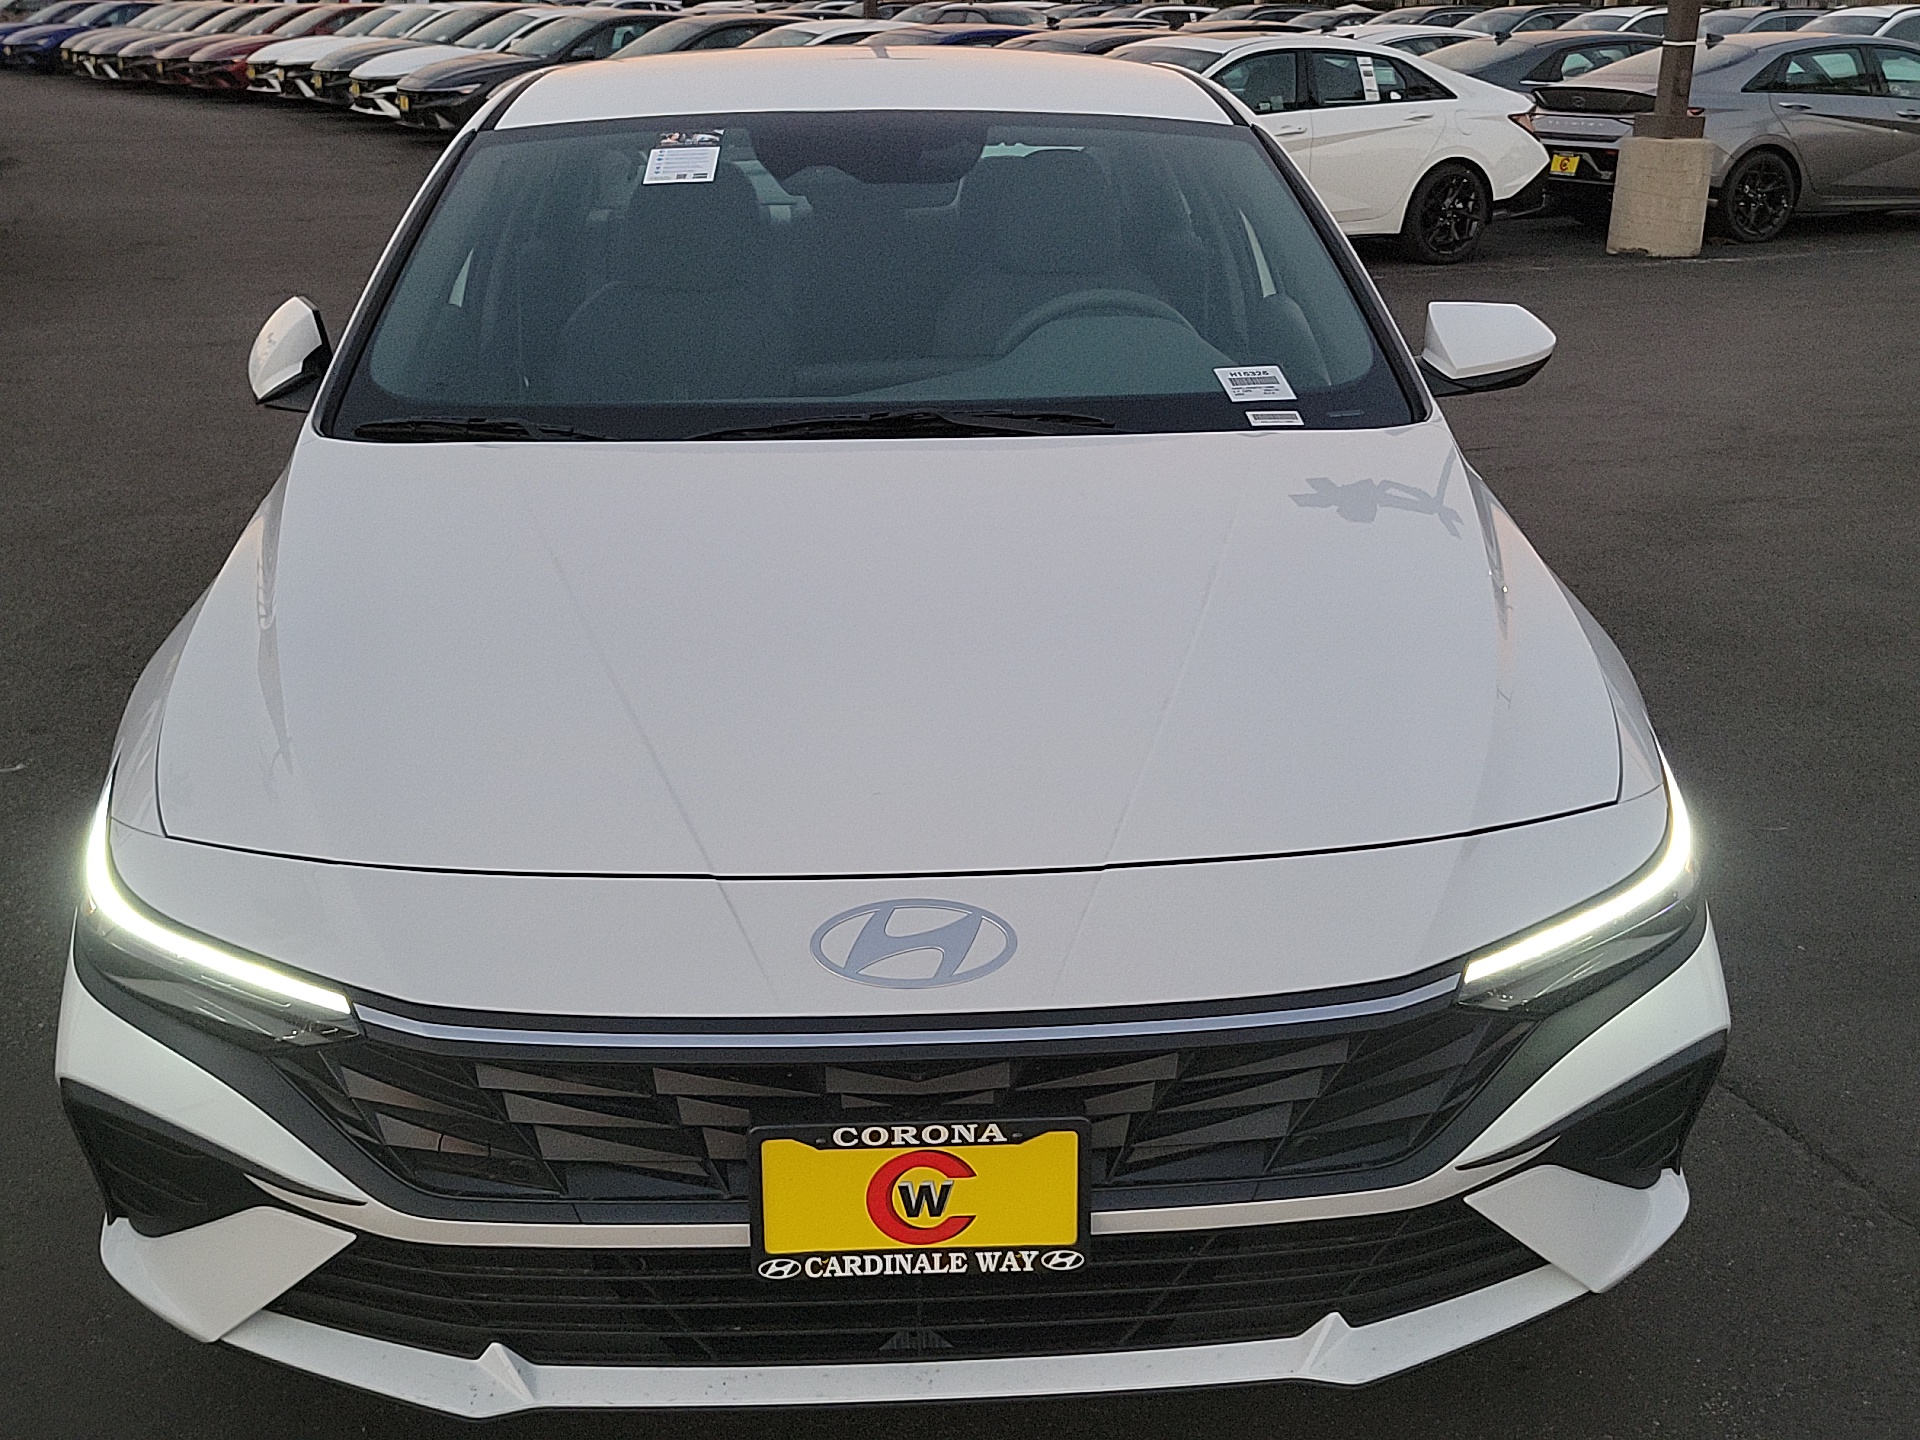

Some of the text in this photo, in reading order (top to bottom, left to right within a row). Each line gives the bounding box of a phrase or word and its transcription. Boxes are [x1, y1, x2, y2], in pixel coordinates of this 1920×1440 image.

[832, 1123, 1007, 1147] CORONA
[897, 1180, 955, 1218] W
[804, 1252, 968, 1279] CARDINALE
[974, 1250, 1040, 1273] WAY
